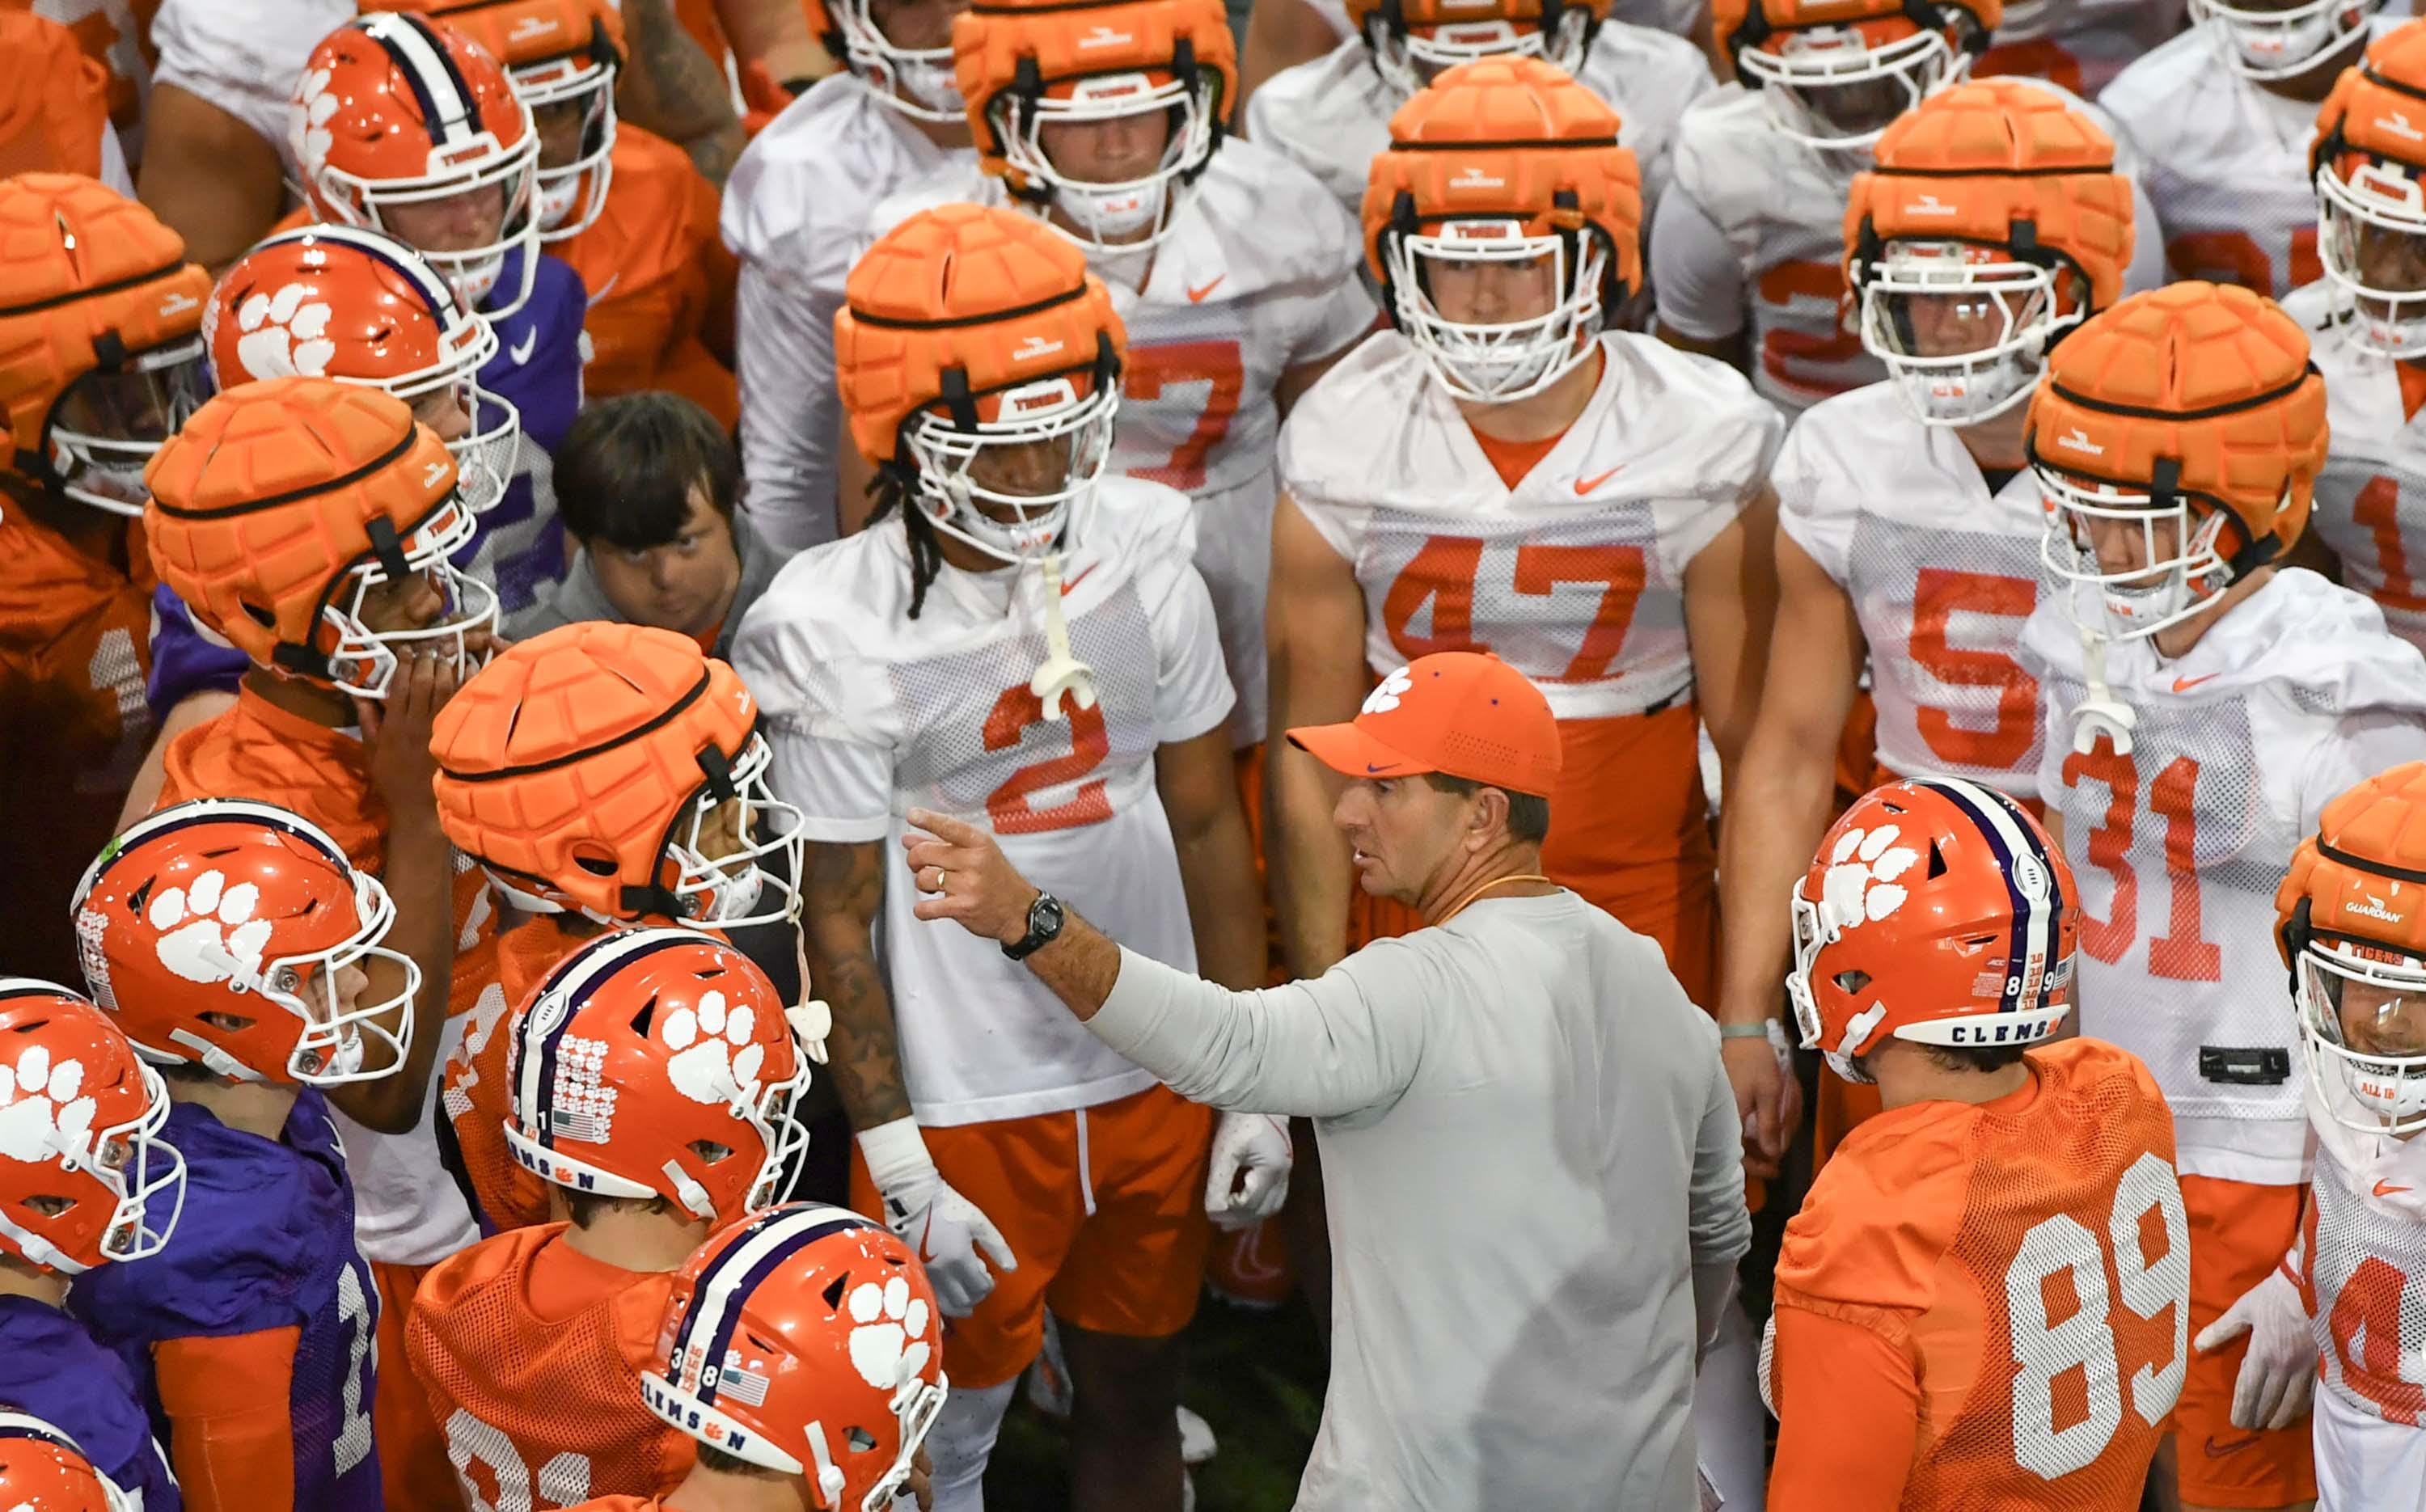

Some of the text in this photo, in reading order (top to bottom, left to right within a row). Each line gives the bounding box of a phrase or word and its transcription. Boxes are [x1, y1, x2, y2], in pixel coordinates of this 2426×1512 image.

[1382, 534, 1646, 685] 47
[1909, 567, 2040, 770] 5
[983, 680, 1114, 834] 2
[2062, 733, 2221, 982] 31
[2346, 902, 2402, 923] GUARDIAN
[2351, 944, 2405, 967] TIGERS
[2360, 1082, 2382, 1099] ALL
[702, 1365, 718, 1387] 8
[2005, 1151, 2191, 1480] 89
